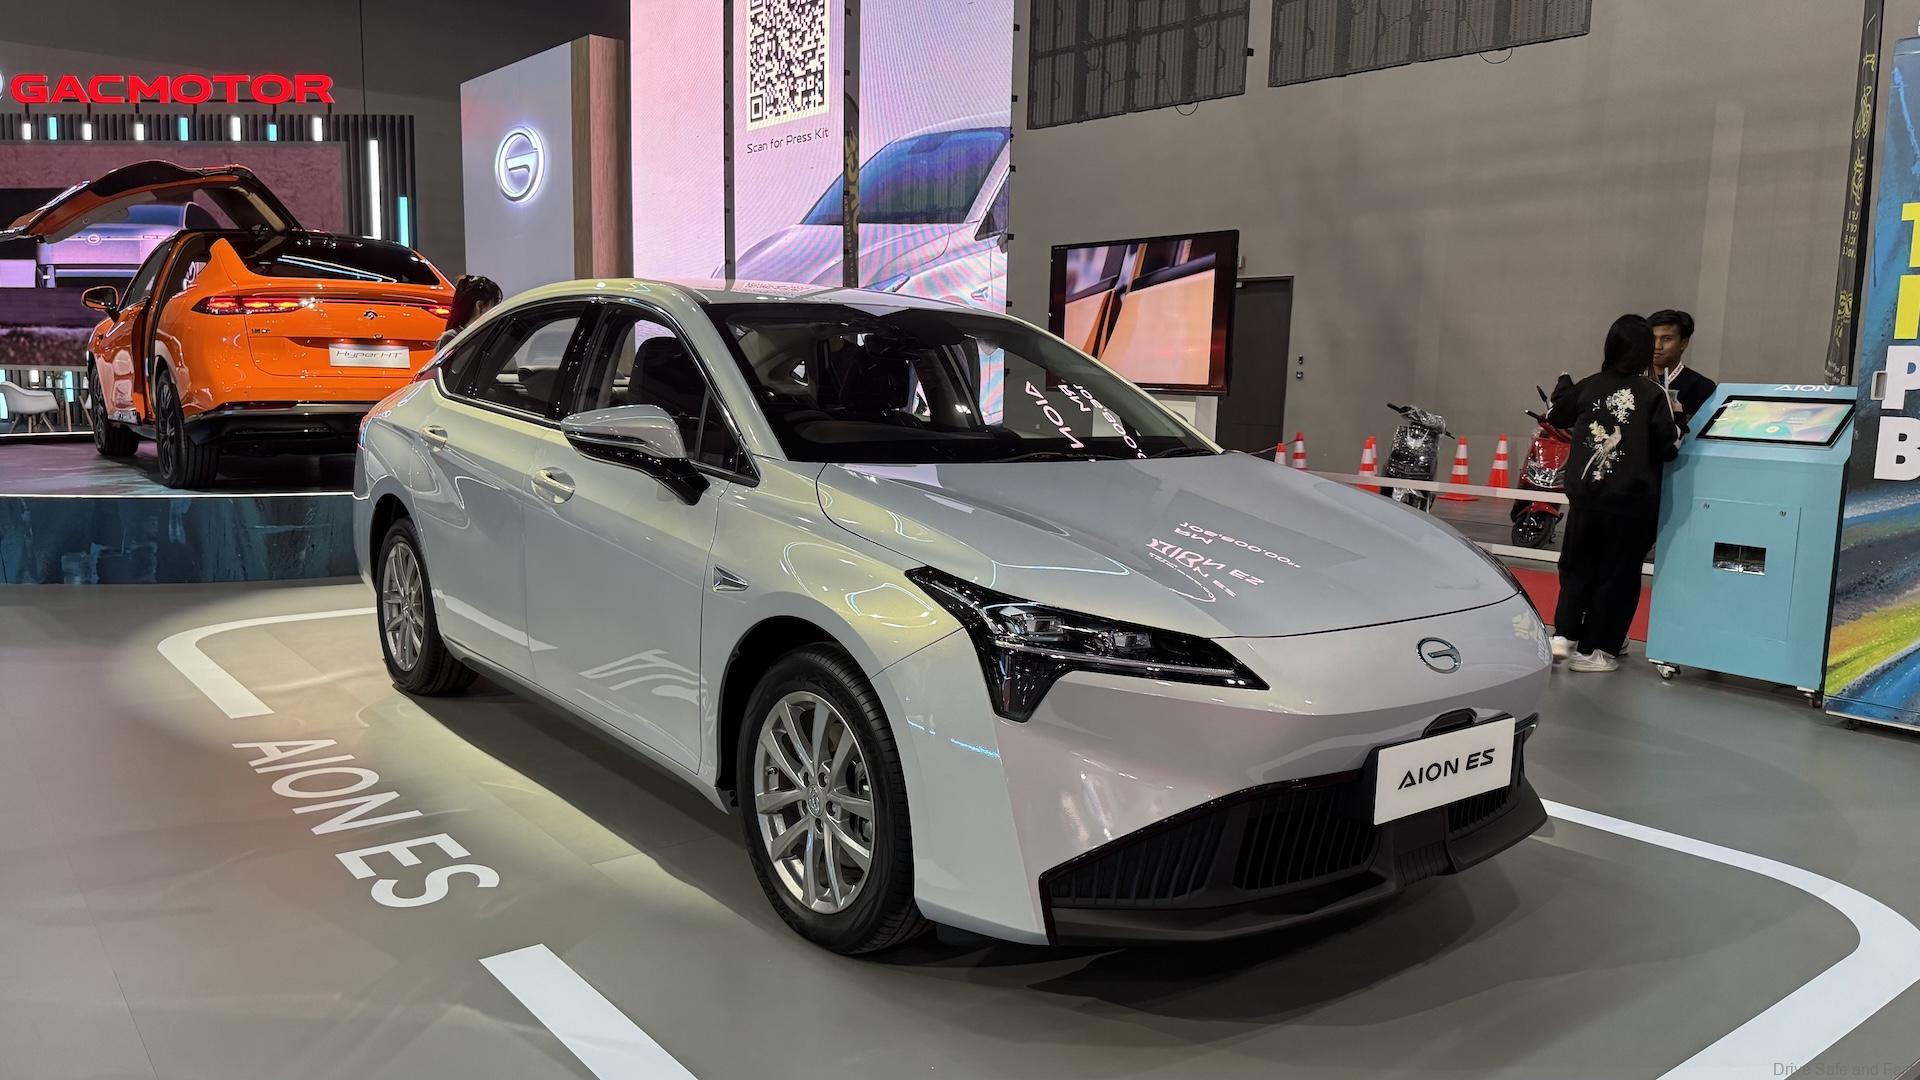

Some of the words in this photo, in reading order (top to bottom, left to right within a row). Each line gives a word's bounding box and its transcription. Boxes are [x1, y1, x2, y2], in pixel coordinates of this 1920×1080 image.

[746, 143, 768, 154] Scan
[770, 138, 783, 149] for
[786, 133, 812, 145] Press
[814, 127, 829, 140] Kit
[1775, 384, 1835, 393] AION
[1397, 757, 1459, 790] AION
[1465, 748, 1496, 771] ES
[232, 739, 424, 835] AION
[335, 833, 500, 908] ES
